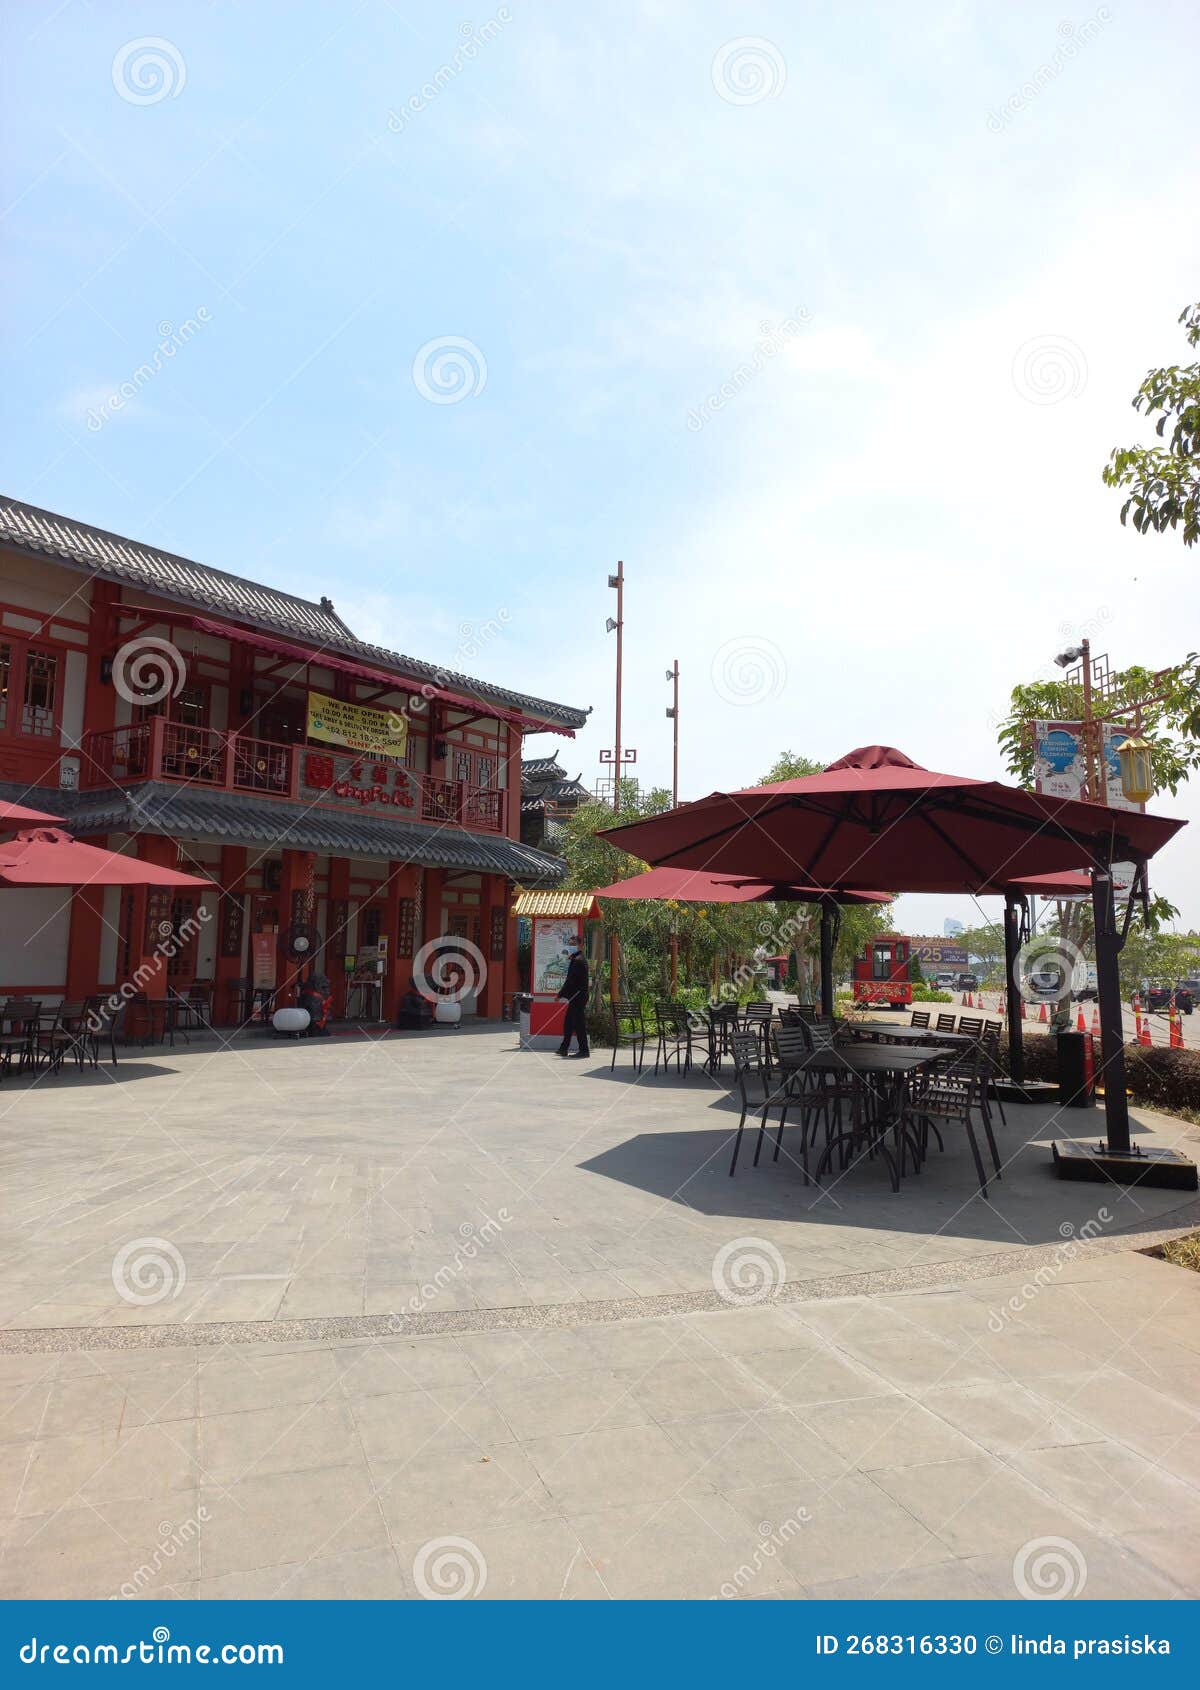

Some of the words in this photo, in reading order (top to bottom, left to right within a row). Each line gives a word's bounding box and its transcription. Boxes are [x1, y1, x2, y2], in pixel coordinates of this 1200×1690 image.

[328, 701, 340, 709] WE
[342, 704, 359, 714] ARE
[361, 711, 385, 719] OPEN
